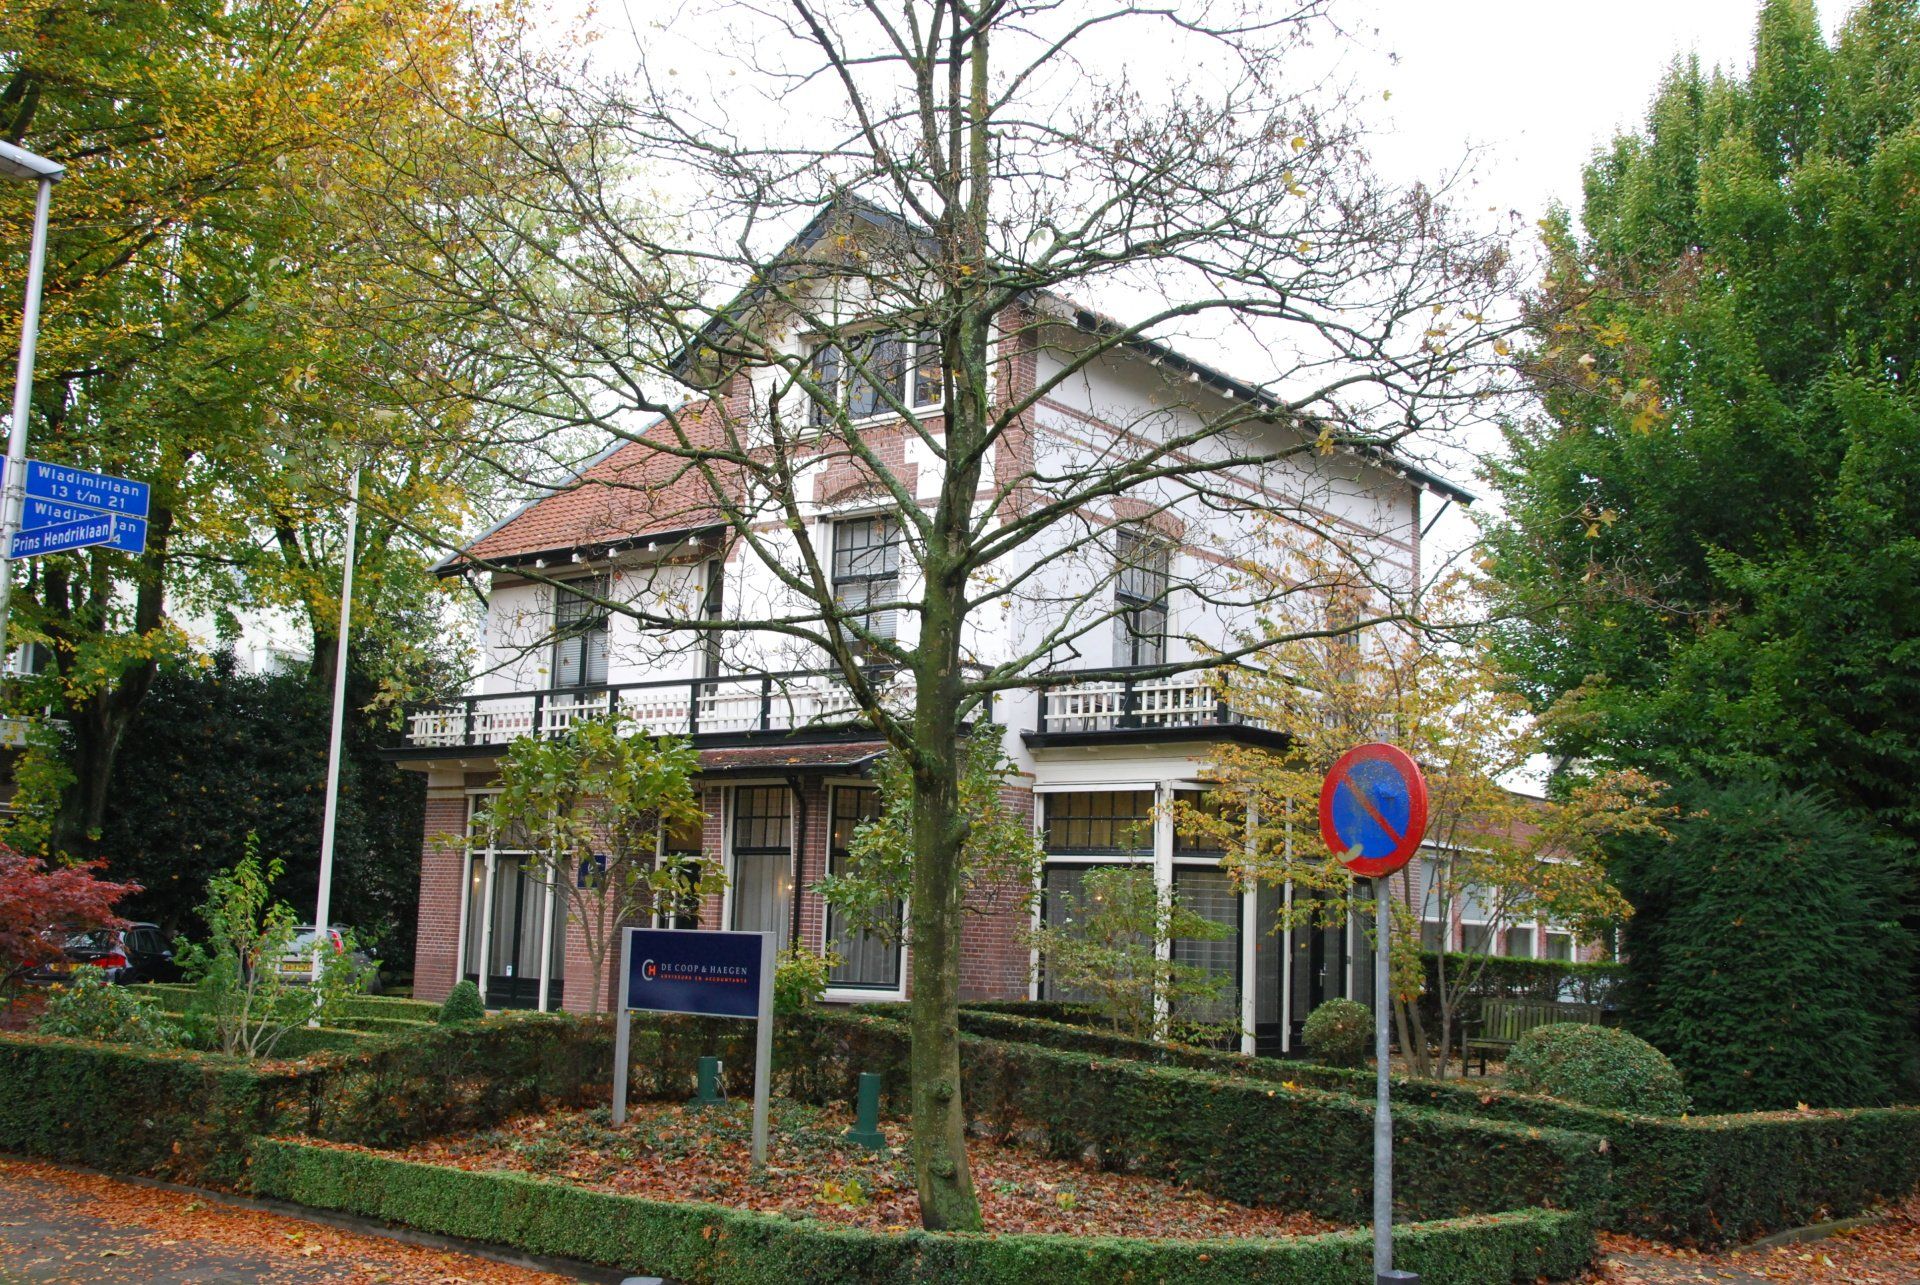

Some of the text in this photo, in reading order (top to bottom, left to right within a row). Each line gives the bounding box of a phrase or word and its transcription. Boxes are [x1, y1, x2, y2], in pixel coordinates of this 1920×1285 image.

[38, 465, 140, 497] Wladimirlaan
[51, 484, 126, 509] 13 t/m 21
[34, 501, 137, 533] Wladiman
[12, 523, 109, 553] Prins Hendriklaan
[661, 963, 748, 975] DE COOP & HAEGEN
